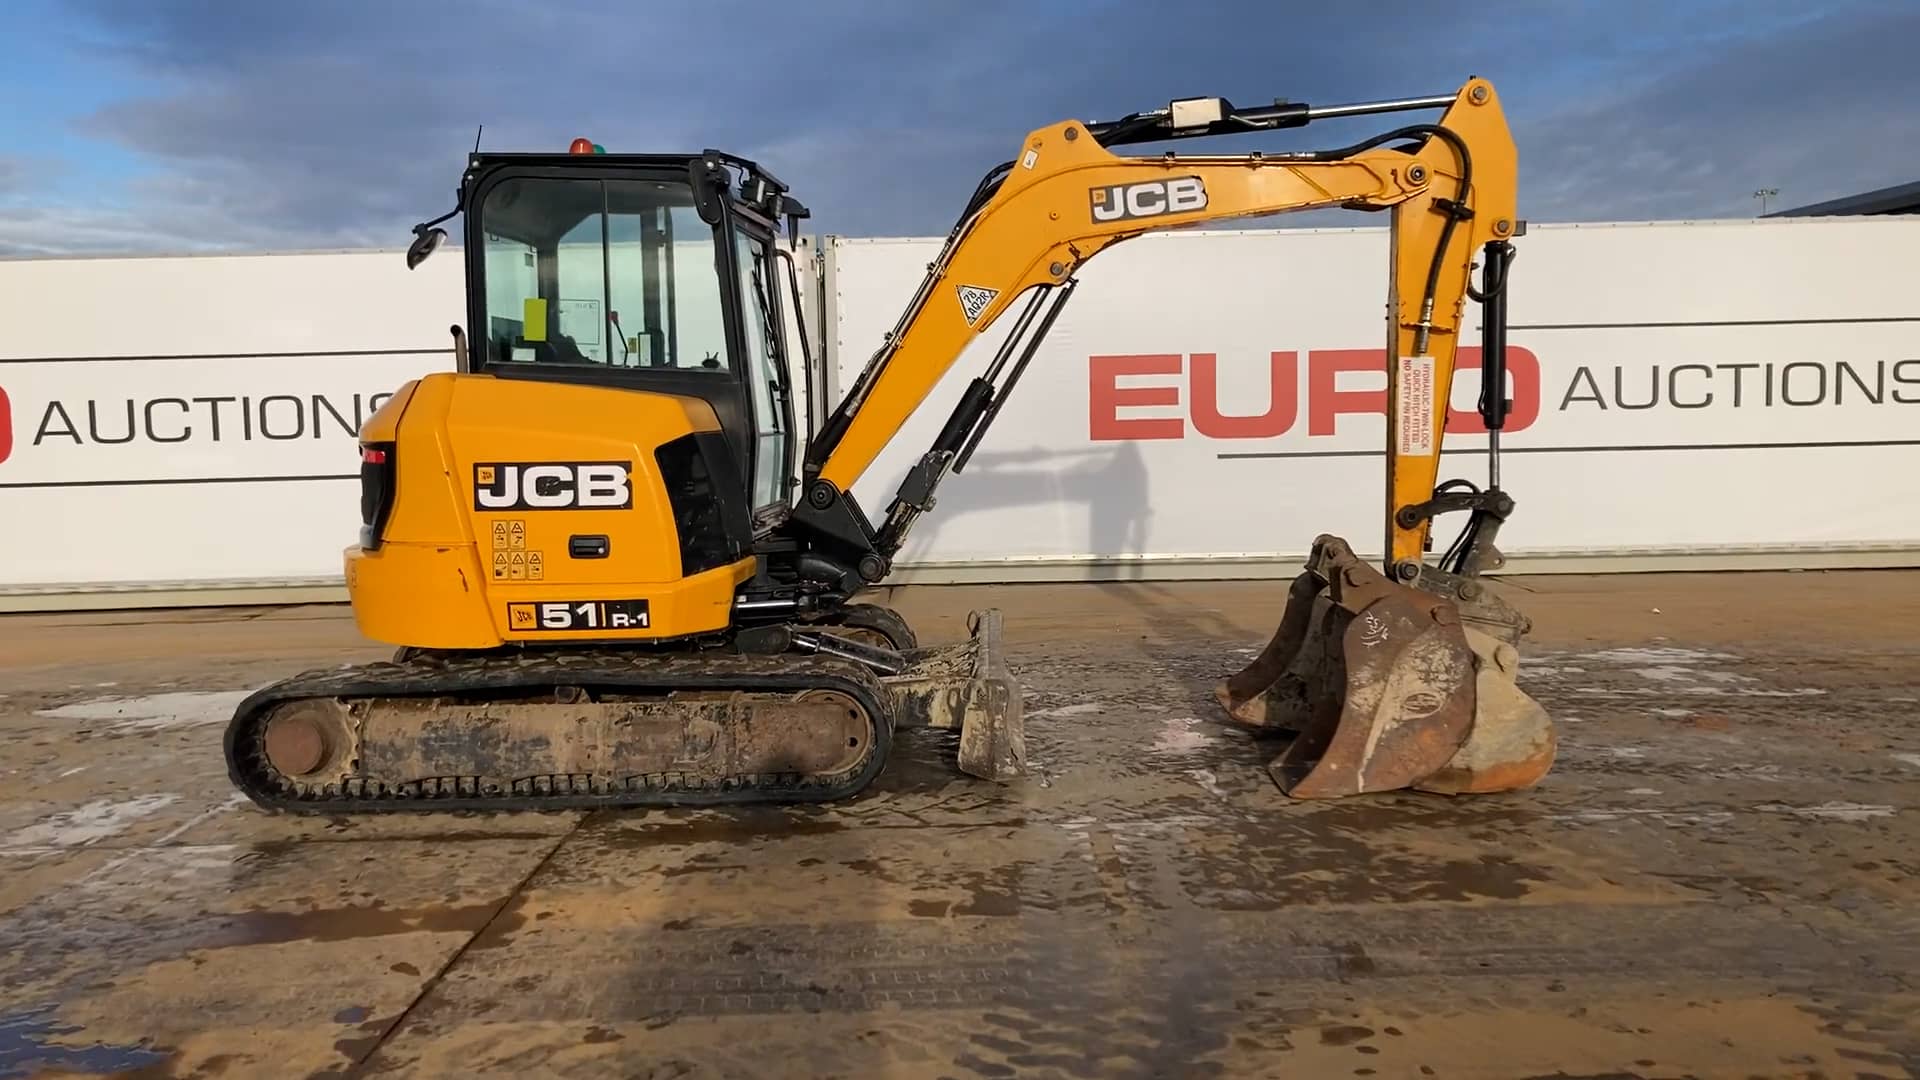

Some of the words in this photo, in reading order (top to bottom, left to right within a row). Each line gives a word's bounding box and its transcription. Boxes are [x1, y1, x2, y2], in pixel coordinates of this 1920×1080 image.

[1094, 178, 1207, 220] JCB
[963, 290, 977, 304] 78
[1403, 373, 1411, 400] SAFETY
[1412, 369, 1421, 393] QUICK
[1559, 360, 1920, 411] AUCTIONS
[1412, 394, 1420, 416] HITCH
[1402, 415, 1411, 453] REQUIRED
[1412, 418, 1420, 443] FITTED
[477, 465, 630, 507] JCB
[542, 602, 597, 628] 51
[612, 612, 648, 627] R-1
